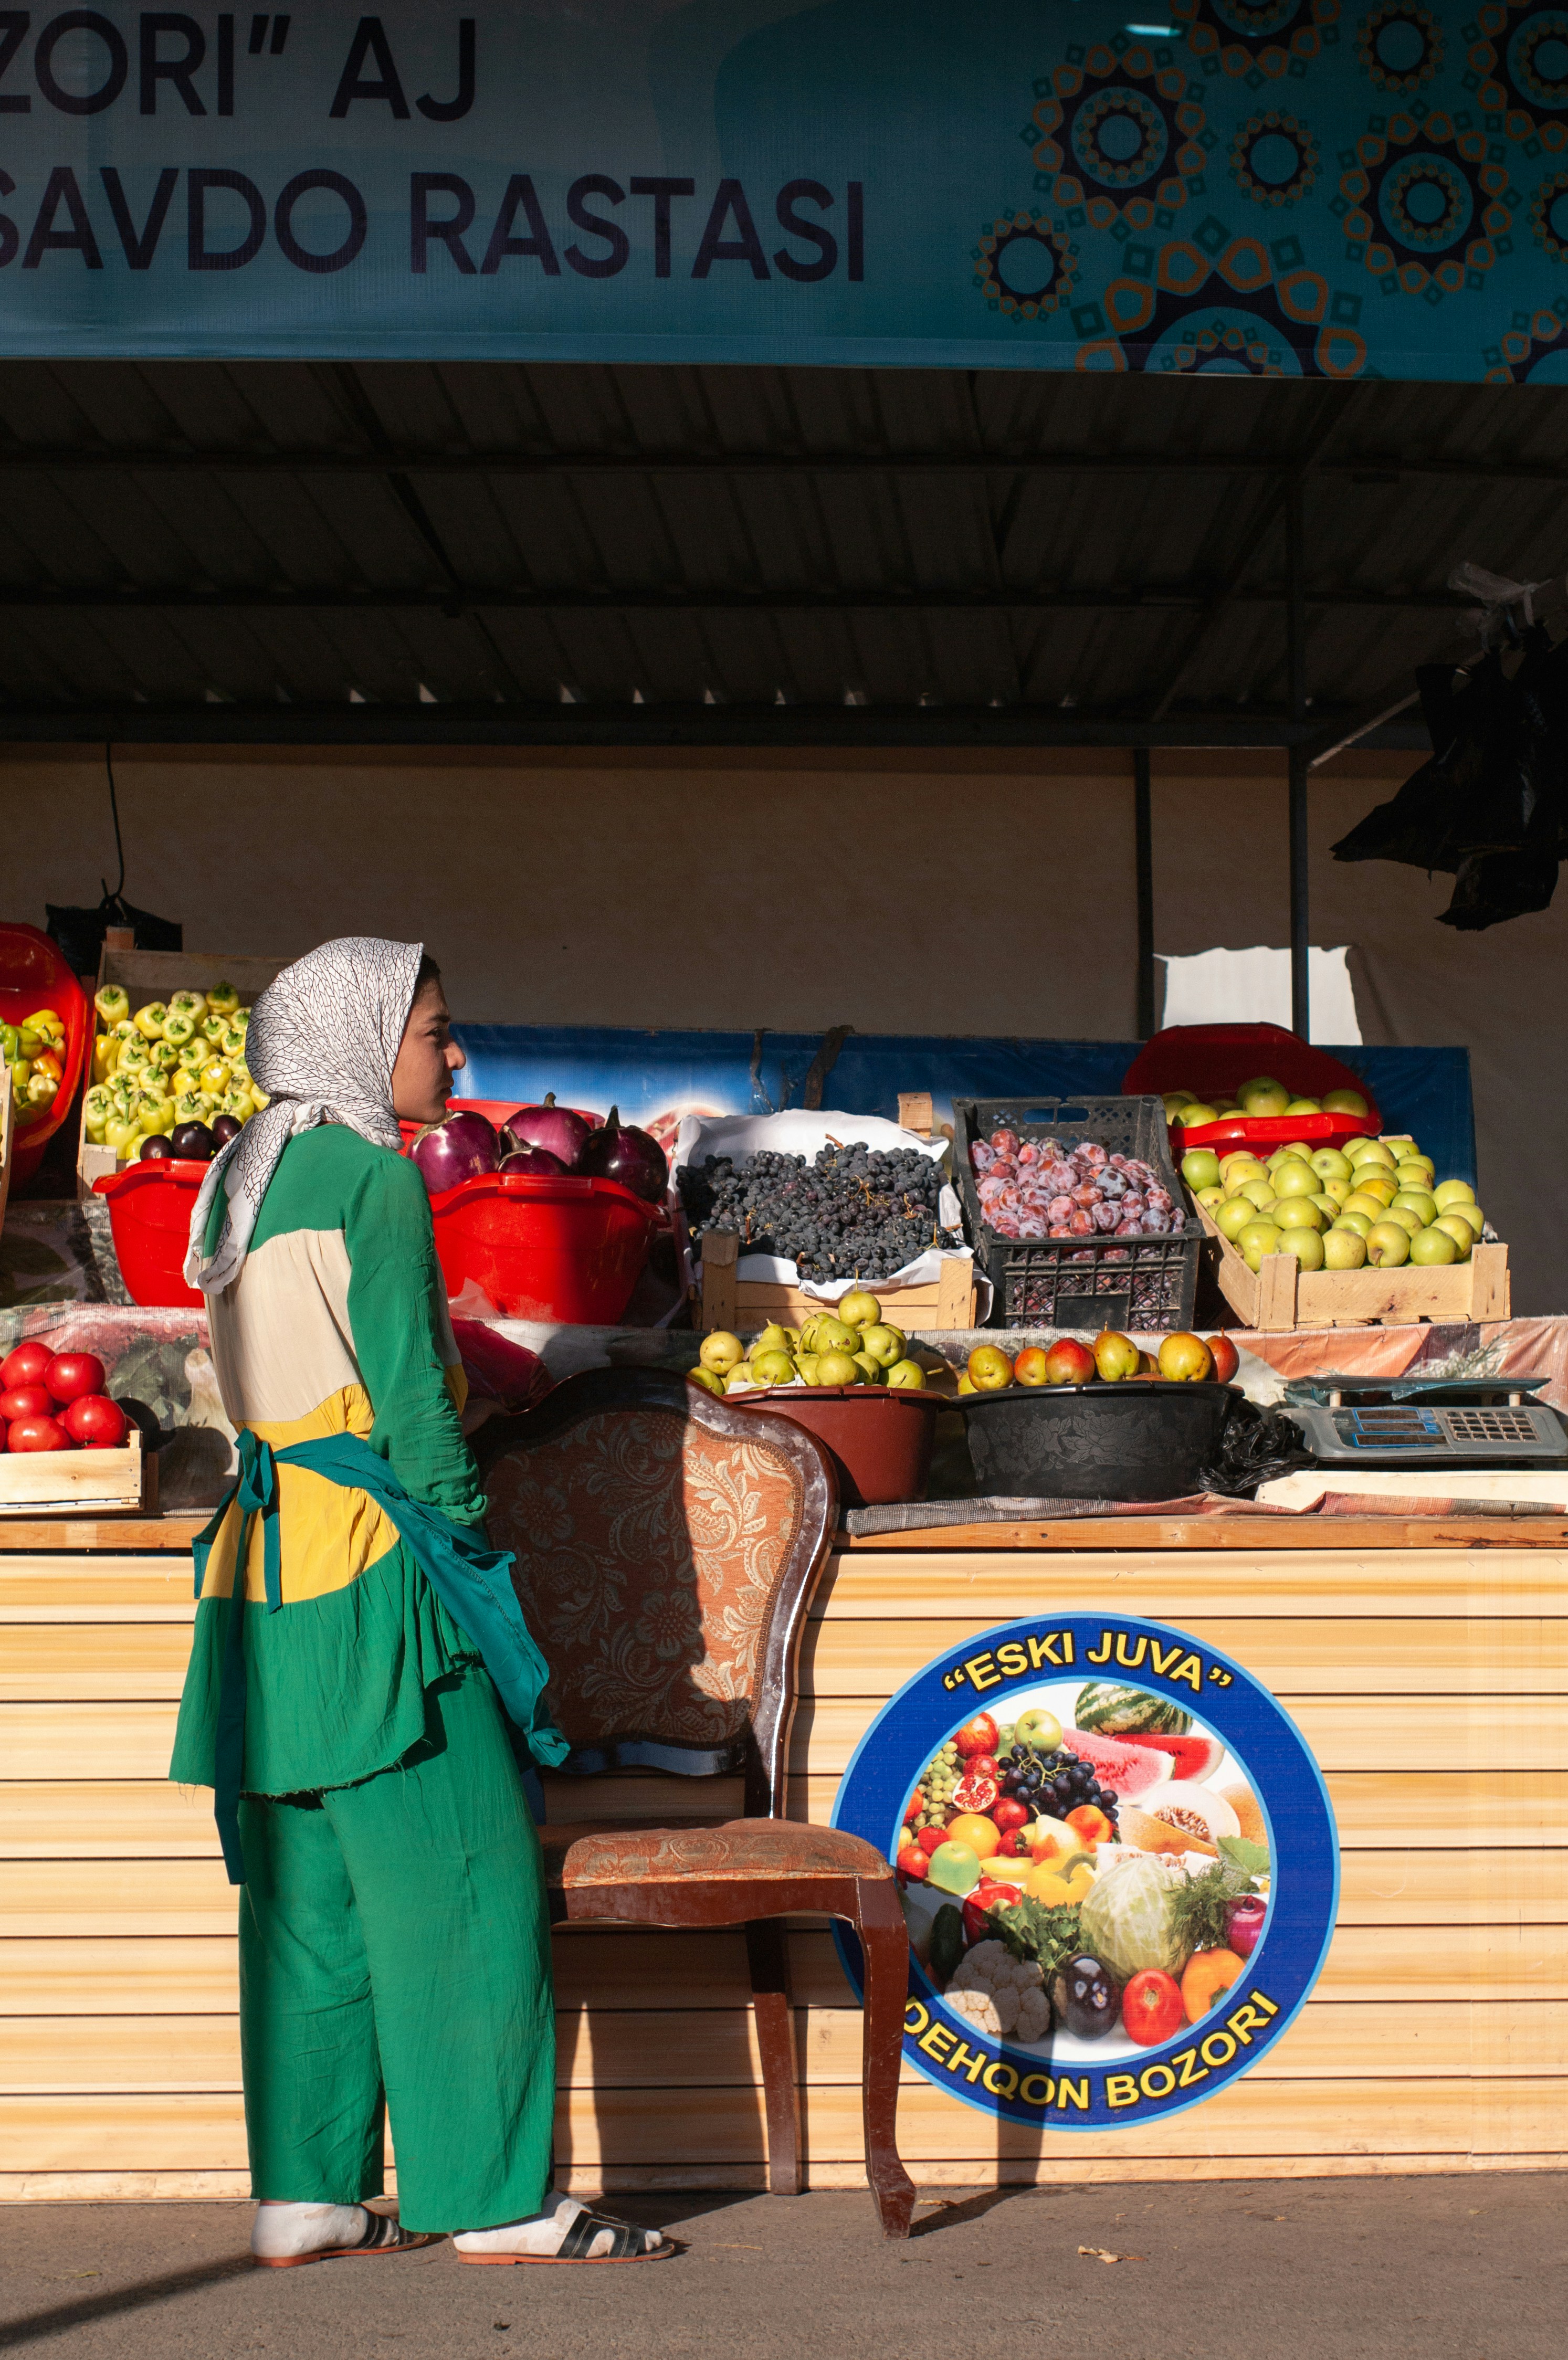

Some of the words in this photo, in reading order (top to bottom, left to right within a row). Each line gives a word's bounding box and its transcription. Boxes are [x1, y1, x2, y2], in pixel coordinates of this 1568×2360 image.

[329, 16, 477, 122] AJ
[411, 172, 865, 282] RASTASI
[944, 1632, 1074, 1691] “ESKI
[1089, 1632, 1232, 1691] JUVA”
[904, 1997, 1089, 2109] DEHQON
[1107, 1990, 1279, 2108] BOZORI
